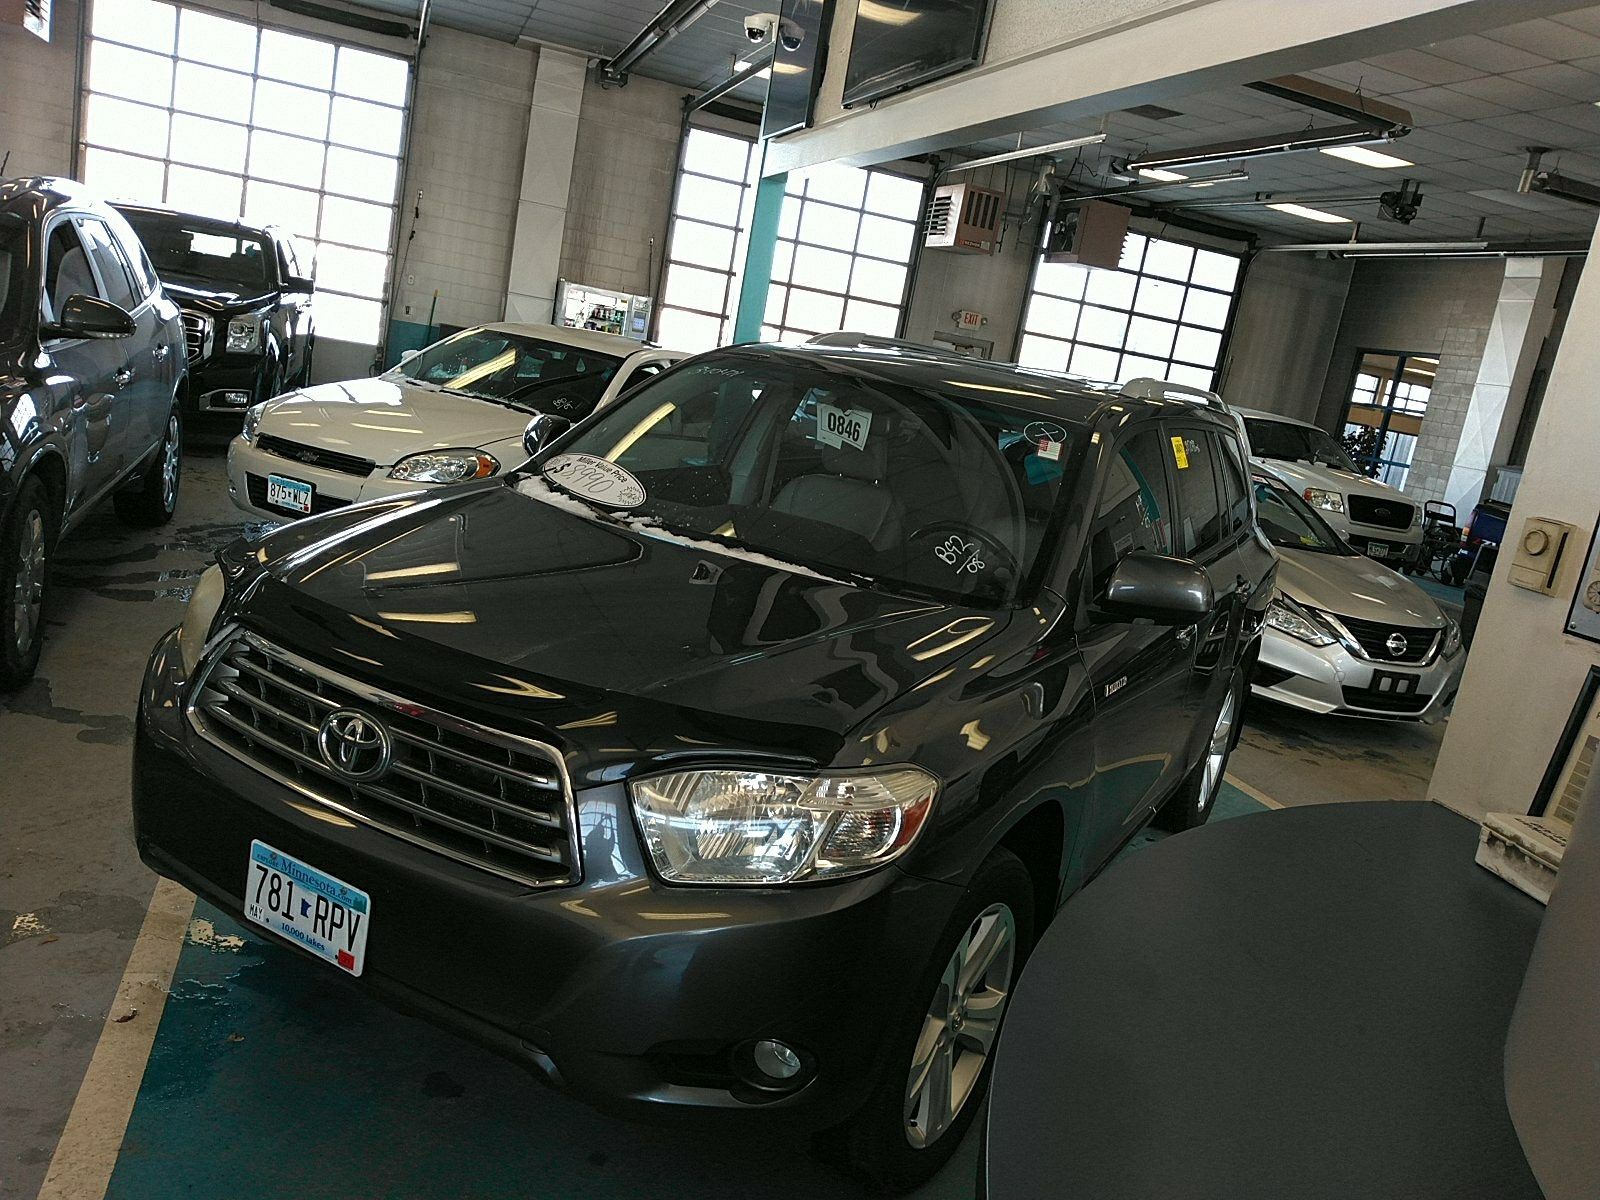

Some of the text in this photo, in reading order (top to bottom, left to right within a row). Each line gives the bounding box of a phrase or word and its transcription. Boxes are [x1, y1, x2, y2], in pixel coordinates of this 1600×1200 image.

[963, 312, 979, 325] EXIT
[827, 411, 861, 442] 0846
[594, 461, 613, 473] Value
[610, 469, 628, 483] Price
[270, 483, 287, 500] 875
[249, 903, 263, 920] MAY
[255, 863, 361, 952] 781 RPV
[281, 922, 326, 951] 10,000 lakes
